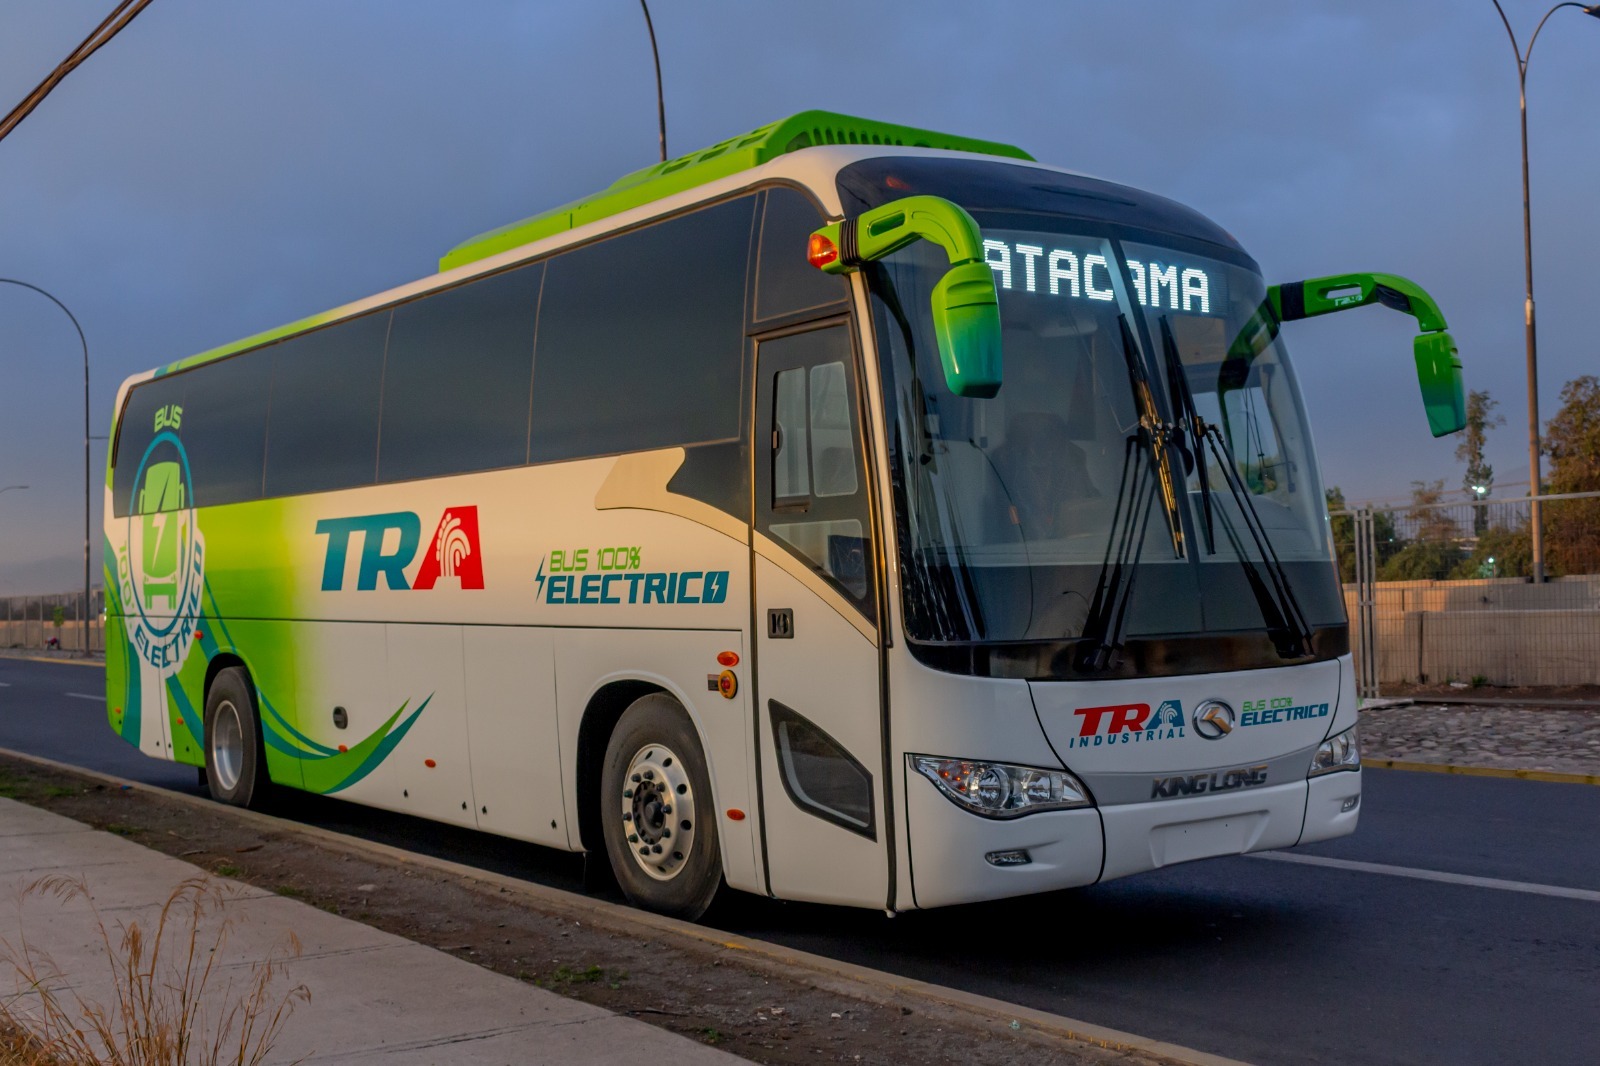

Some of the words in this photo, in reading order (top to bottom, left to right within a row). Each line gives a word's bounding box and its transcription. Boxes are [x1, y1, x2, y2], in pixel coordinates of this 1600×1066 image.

[983, 239, 1209, 313] ATACAMA
[154, 404, 183, 433] BUS
[315, 505, 485, 591] TRA
[549, 549, 589, 572] BUS
[597, 546, 642, 571] 100%
[546, 571, 729, 604] ELECTRICO
[1073, 699, 1185, 737] TRA
[1240, 703, 1329, 727] ELECTRICO
[1242, 699, 1266, 712] BUS
[1270, 697, 1293, 708] 100%
[1069, 727, 1185, 749] INDUSTRIAL
